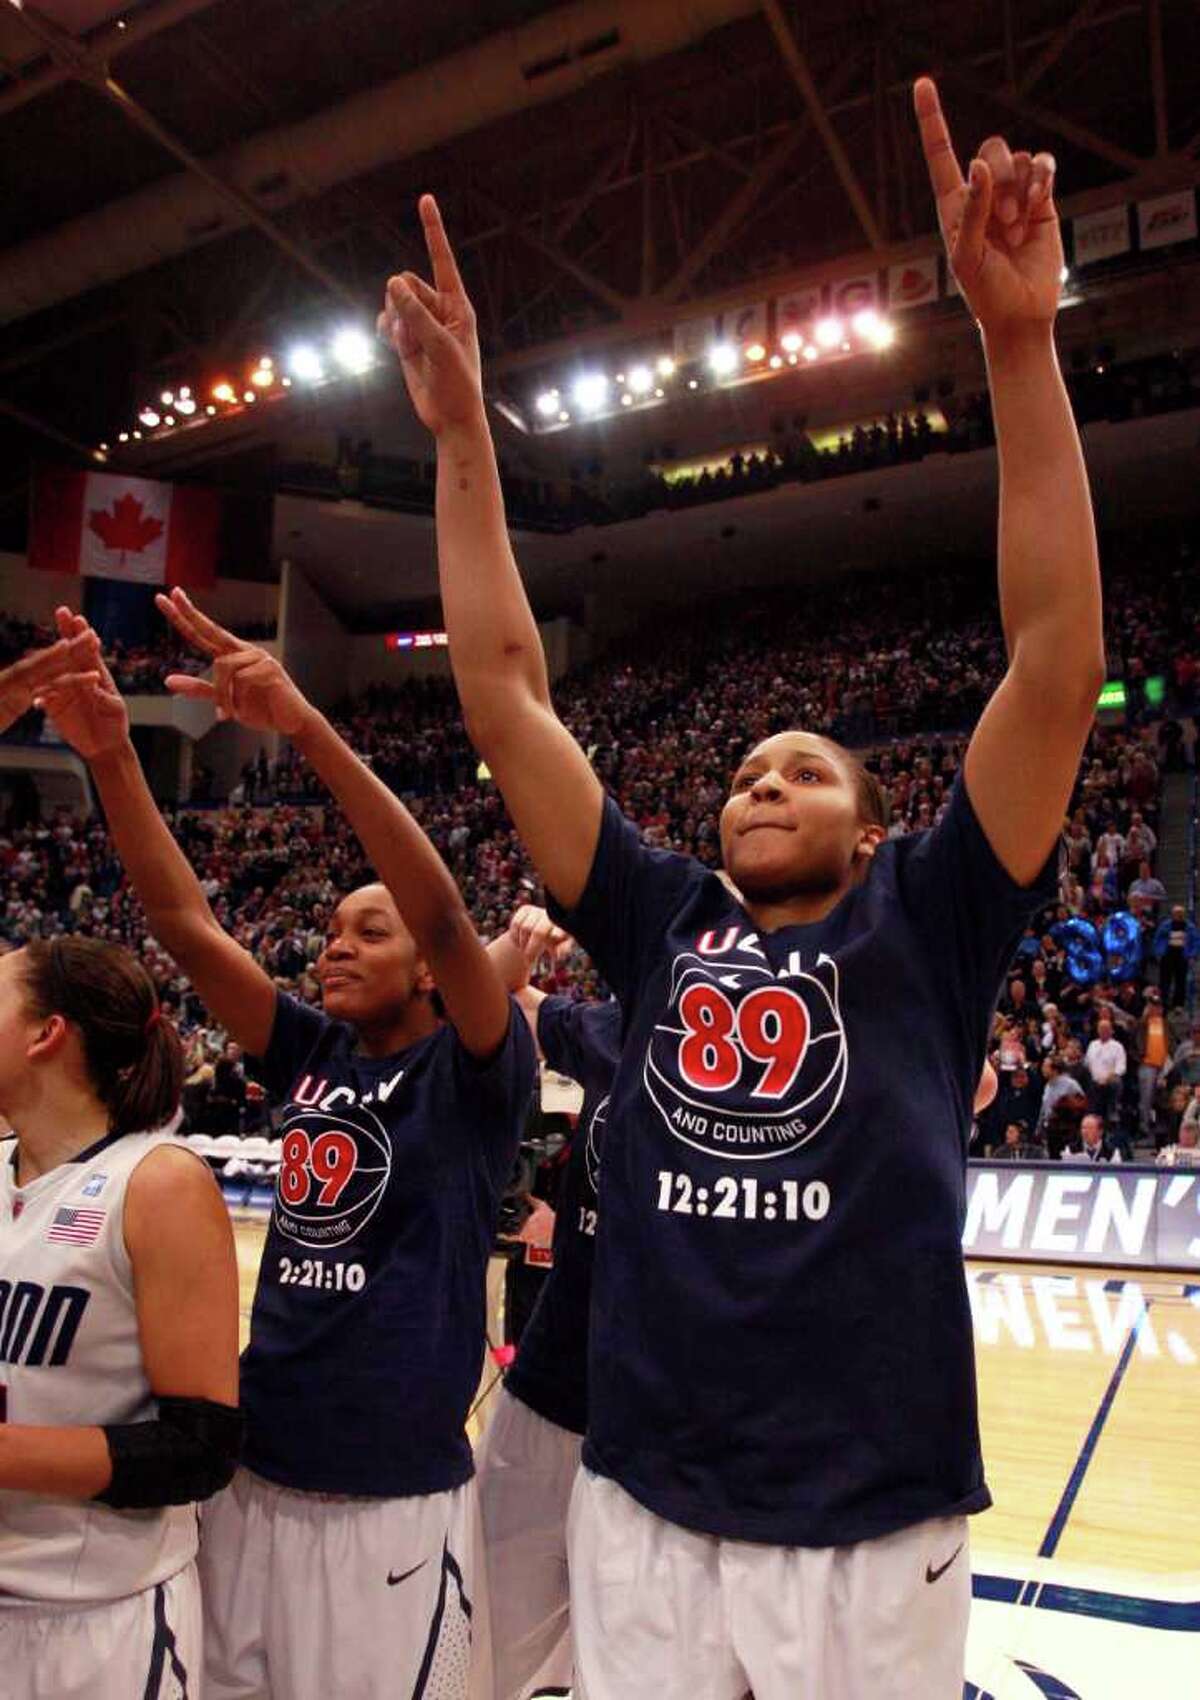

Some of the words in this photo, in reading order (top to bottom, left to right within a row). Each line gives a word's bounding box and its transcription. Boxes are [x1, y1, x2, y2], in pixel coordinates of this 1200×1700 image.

[678, 983, 811, 1099] 89
[671, 1106, 708, 1136] AND
[713, 1118, 807, 1144] COUNTING
[280, 1128, 358, 1207] 89
[657, 1171, 831, 1220] 12:21:10
[279, 1257, 366, 1292] 2:21:10
